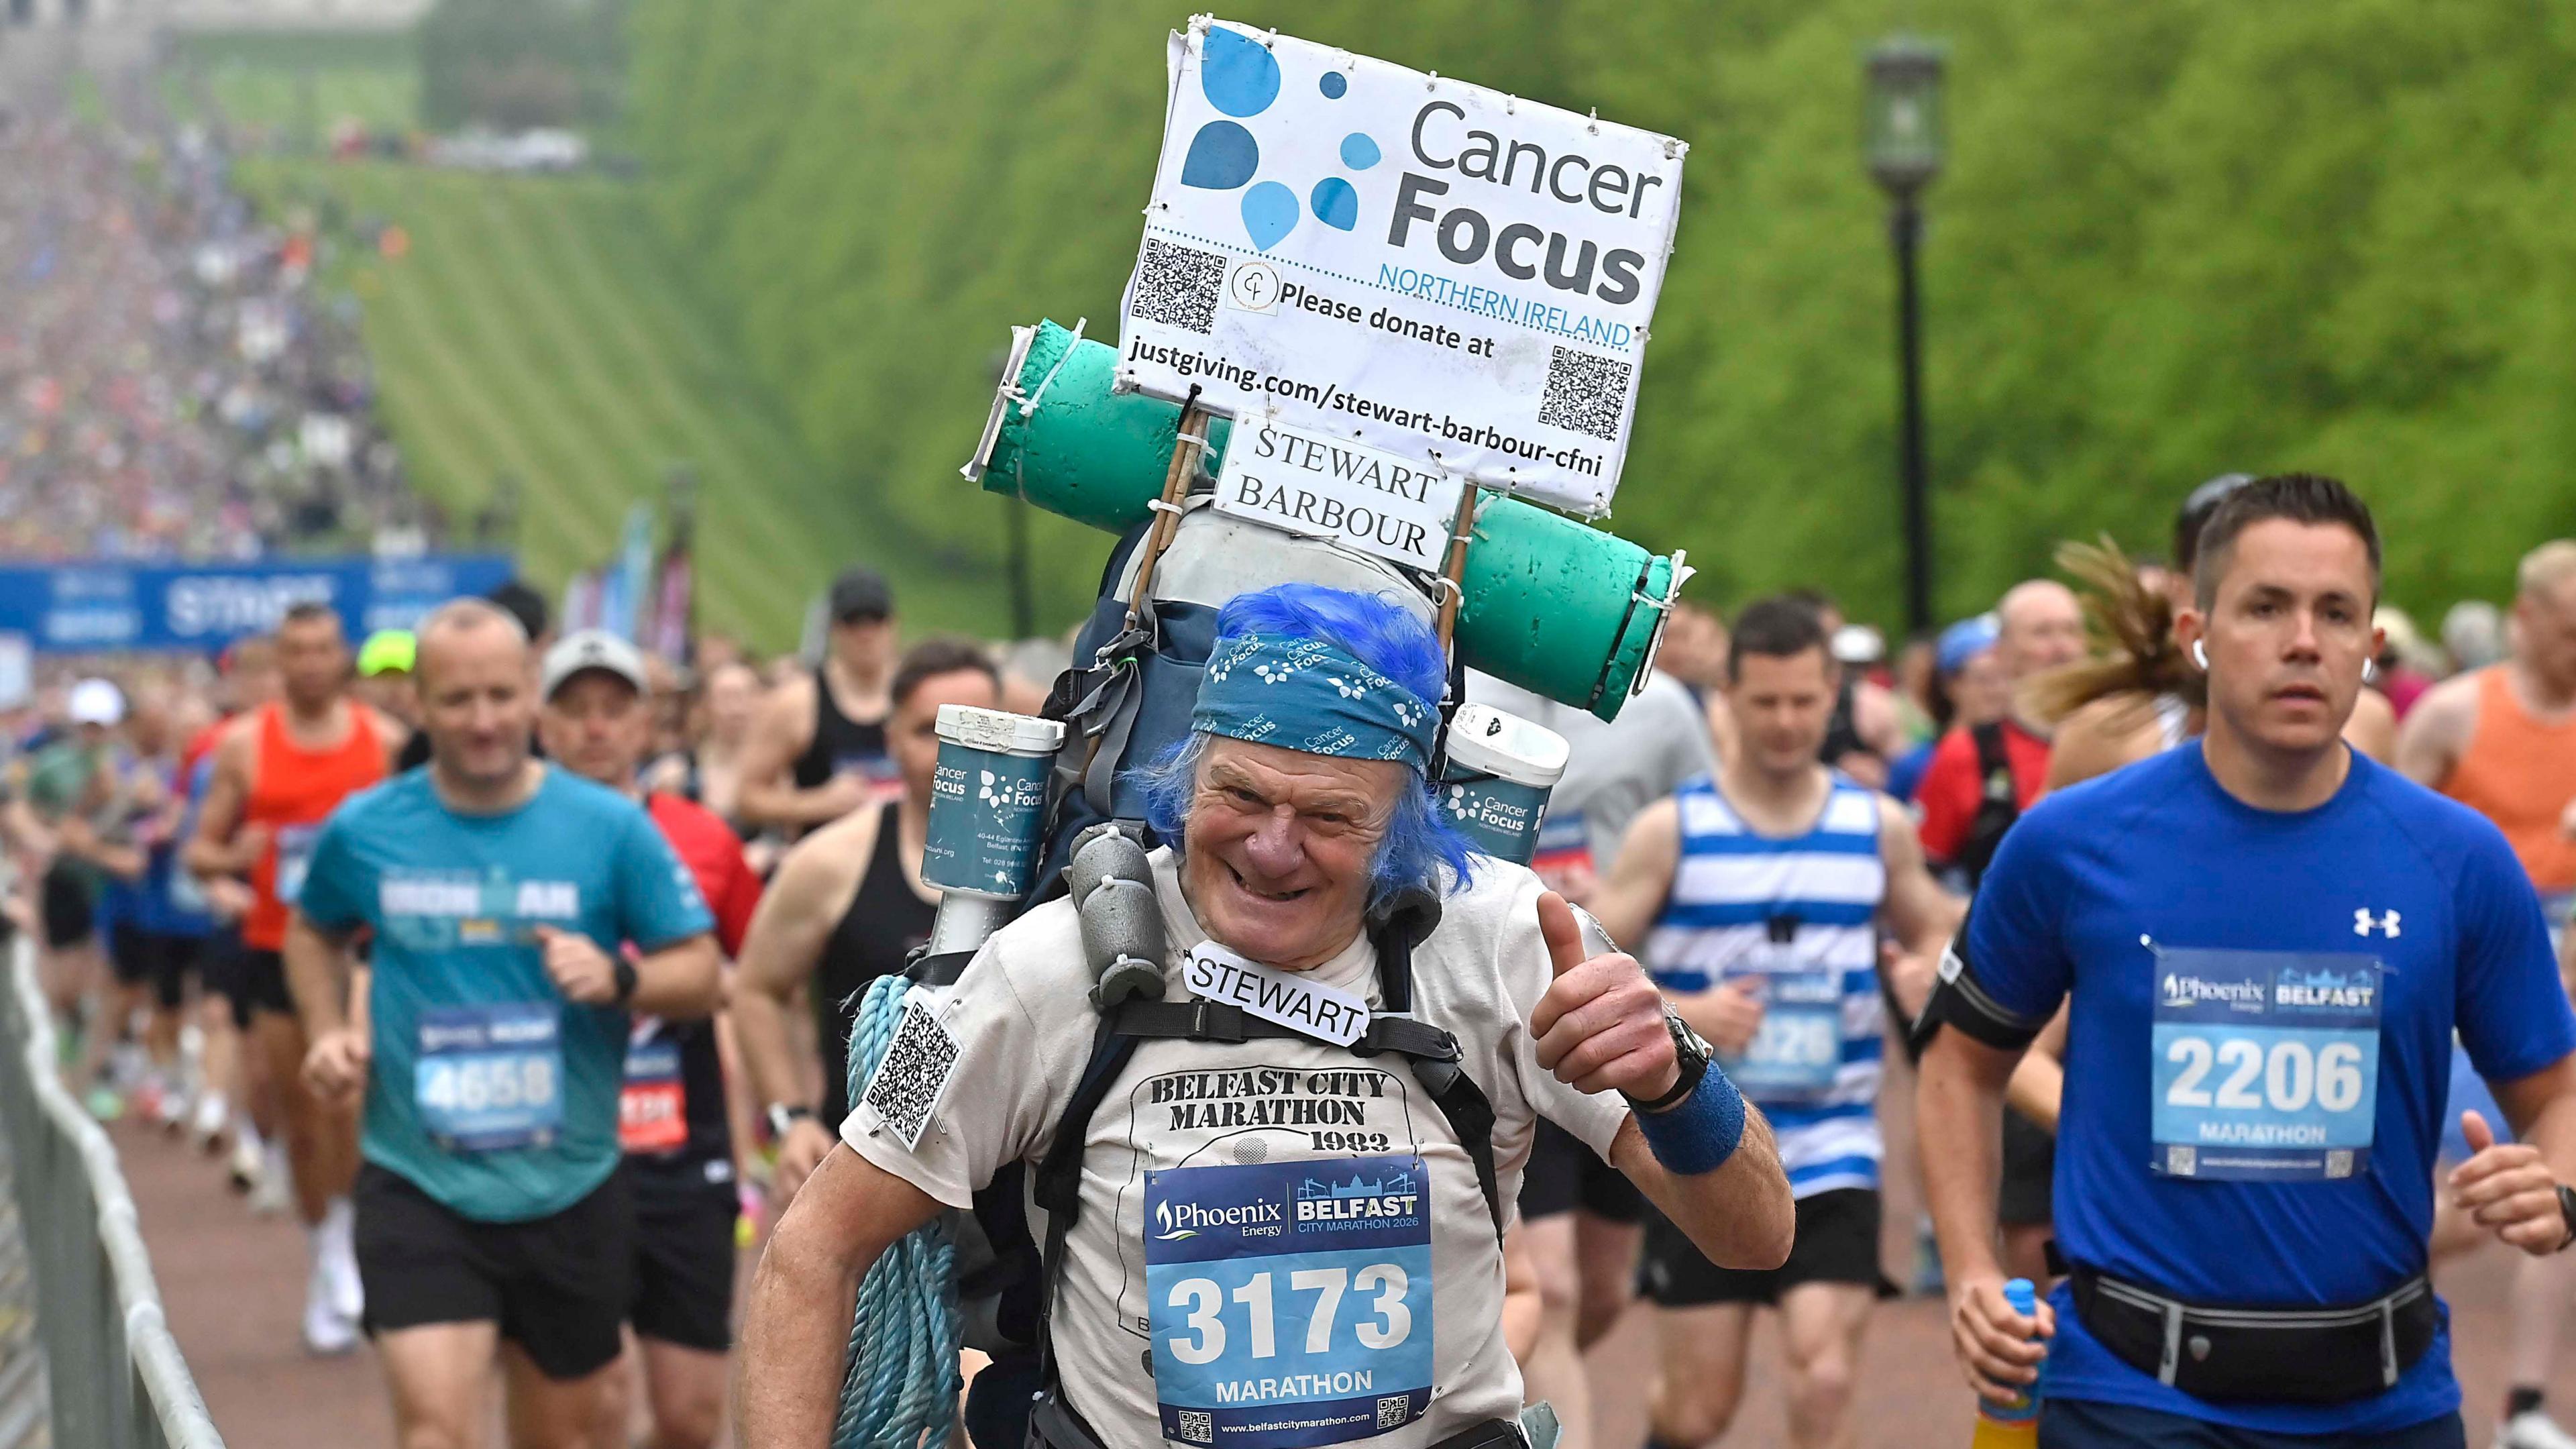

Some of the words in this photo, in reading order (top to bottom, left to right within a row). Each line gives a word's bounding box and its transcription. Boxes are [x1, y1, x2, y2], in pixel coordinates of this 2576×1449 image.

[1412, 101, 1663, 219] Cancer
[1387, 172, 1645, 305] Focus
[1280, 282, 1362, 323] Please
[1370, 306, 1461, 347] donate
[1468, 333, 1495, 358] at
[1380, 264, 1517, 318] NORTHERN
[1523, 302, 1631, 347] IRELAND
[1128, 335, 1603, 477] justgiving.com/stewart-barbour-cfni
[1254, 429, 1438, 504] STEWART
[1235, 475, 1427, 556] BARBOUR
[1230, 713, 1265, 738] Cancer
[1239, 721, 1275, 741] ocus
[1304, 725, 1343, 747] Cancer
[1480, 808, 1525, 830] Focus
[1485, 796, 1528, 817] Cancer
[977, 833, 994, 841] 40-44
[1191, 957, 1363, 1037] STEWART
[2276, 984, 2375, 1007] BELFAST
[1150, 1071, 1301, 1104] BELFAST
[1307, 1072, 1387, 1098] CITY
[2167, 1037, 2363, 1112] 2206
[1169, 1099, 1365, 1130] MARATHON
[2200, 1122, 2326, 1144] MARATHON
[1175, 1197, 1282, 1228] Phoenix
[1297, 1195, 1417, 1221] BELFAST
[1298, 1222, 1324, 1232] CITY
[1327, 1218, 1390, 1232] MARATHON
[1393, 1217, 1419, 1228] 2026
[1242, 1225, 1282, 1237] Energy
[1167, 1263, 1412, 1365] 3173
[1216, 1370, 1373, 1403] MARATHON
[1222, 1413, 1370, 1433] www.belfastcitymarathon.com
